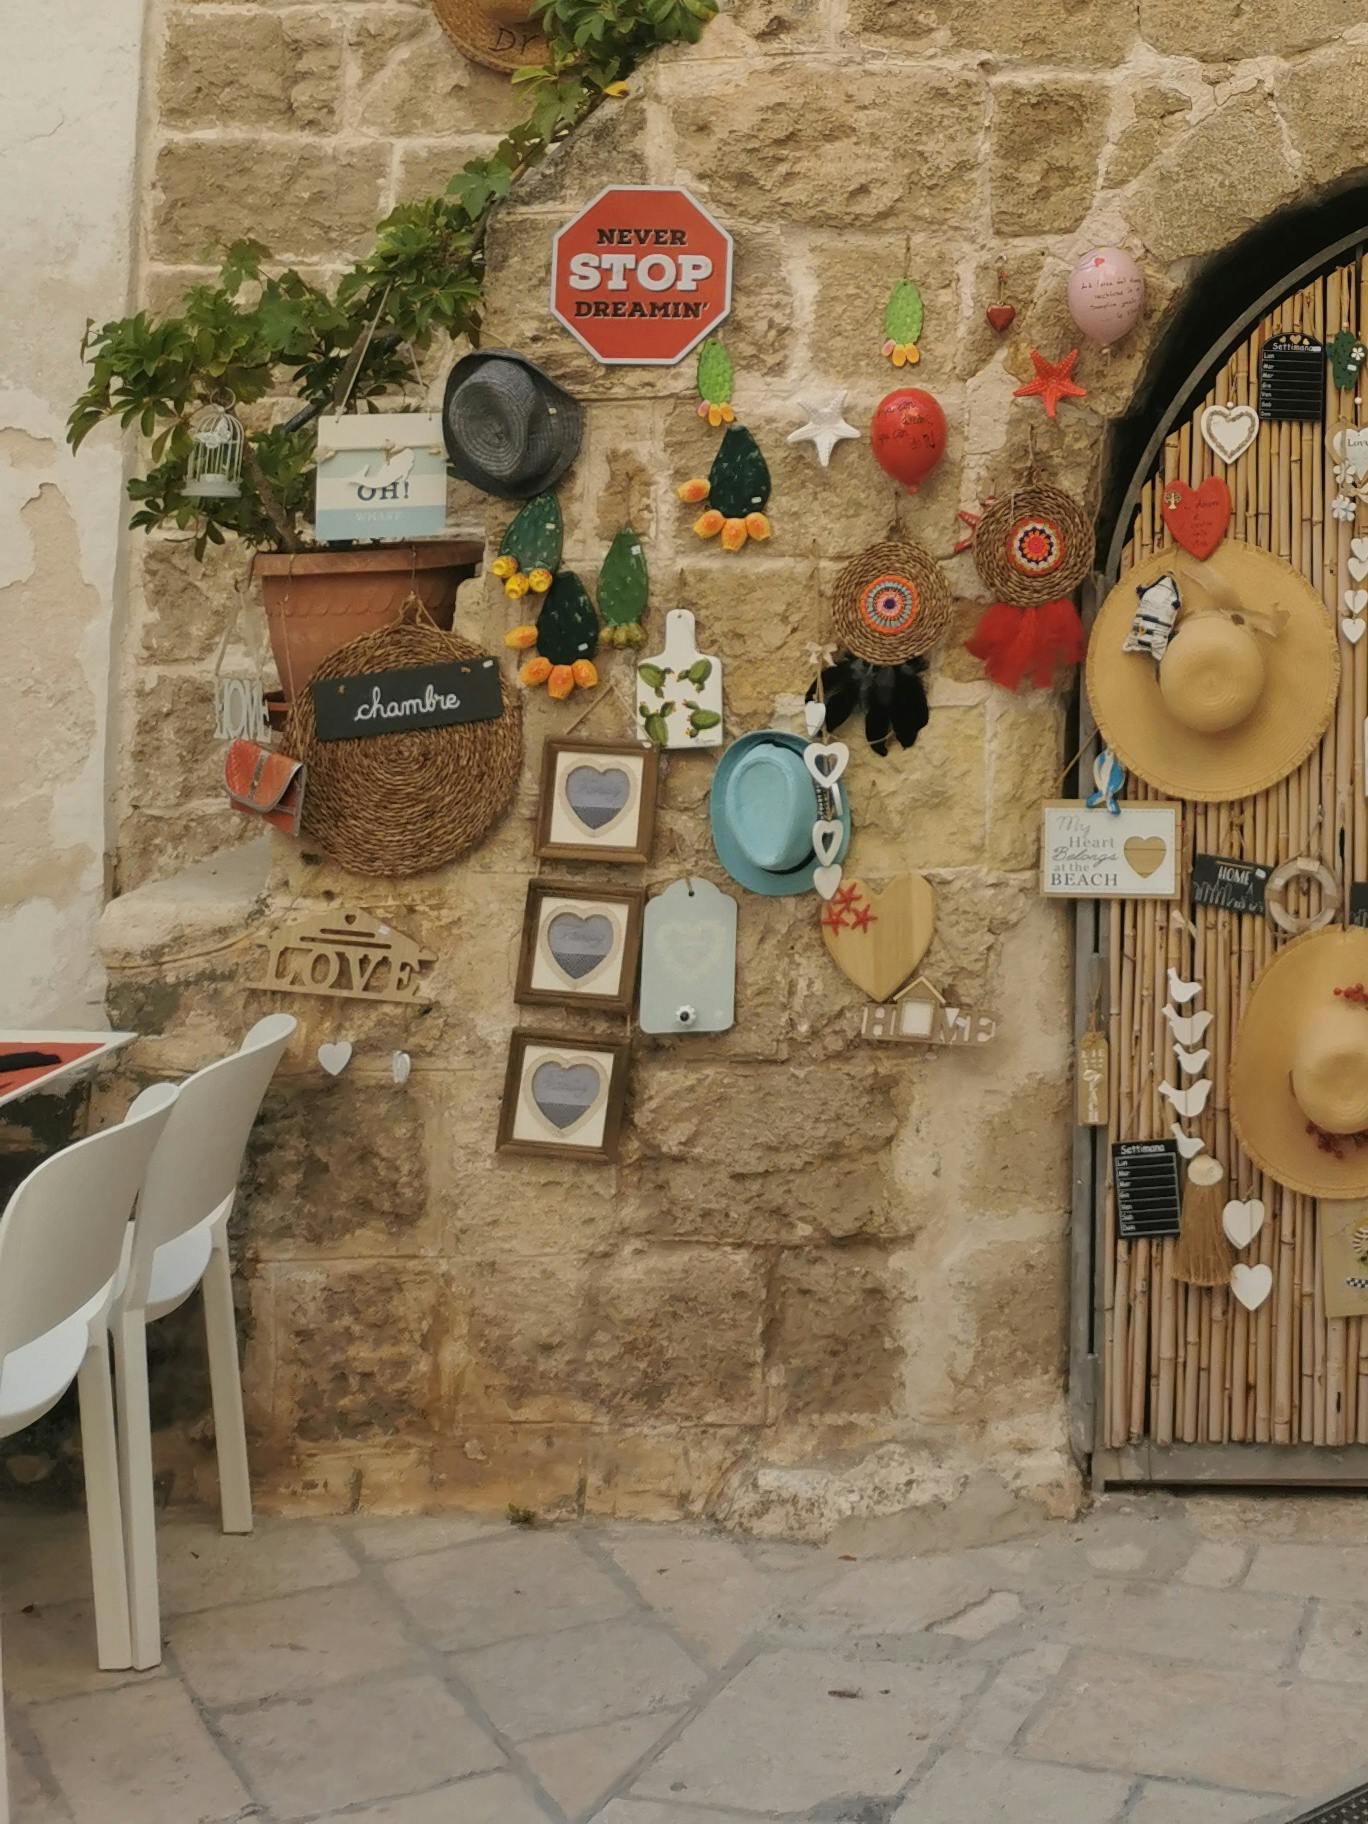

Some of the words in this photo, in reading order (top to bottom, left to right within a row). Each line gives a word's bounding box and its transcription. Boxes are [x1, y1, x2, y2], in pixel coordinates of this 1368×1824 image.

[596, 228, 688, 247] NEVER
[569, 253, 713, 292] STOP
[574, 301, 710, 320] DREAMIN'
[353, 683, 461, 722] chambre
[1056, 815, 1092, 839] My
[1069, 836, 1115, 848] Heart
[1052, 846, 1118, 867] Belongs
[1053, 864, 1066, 872] at
[1069, 862, 1090, 872] the
[1218, 865, 1251, 885] HOME
[1051, 873, 1118, 886] BEACH
[1120, 1144, 1165, 1154] Settimana
